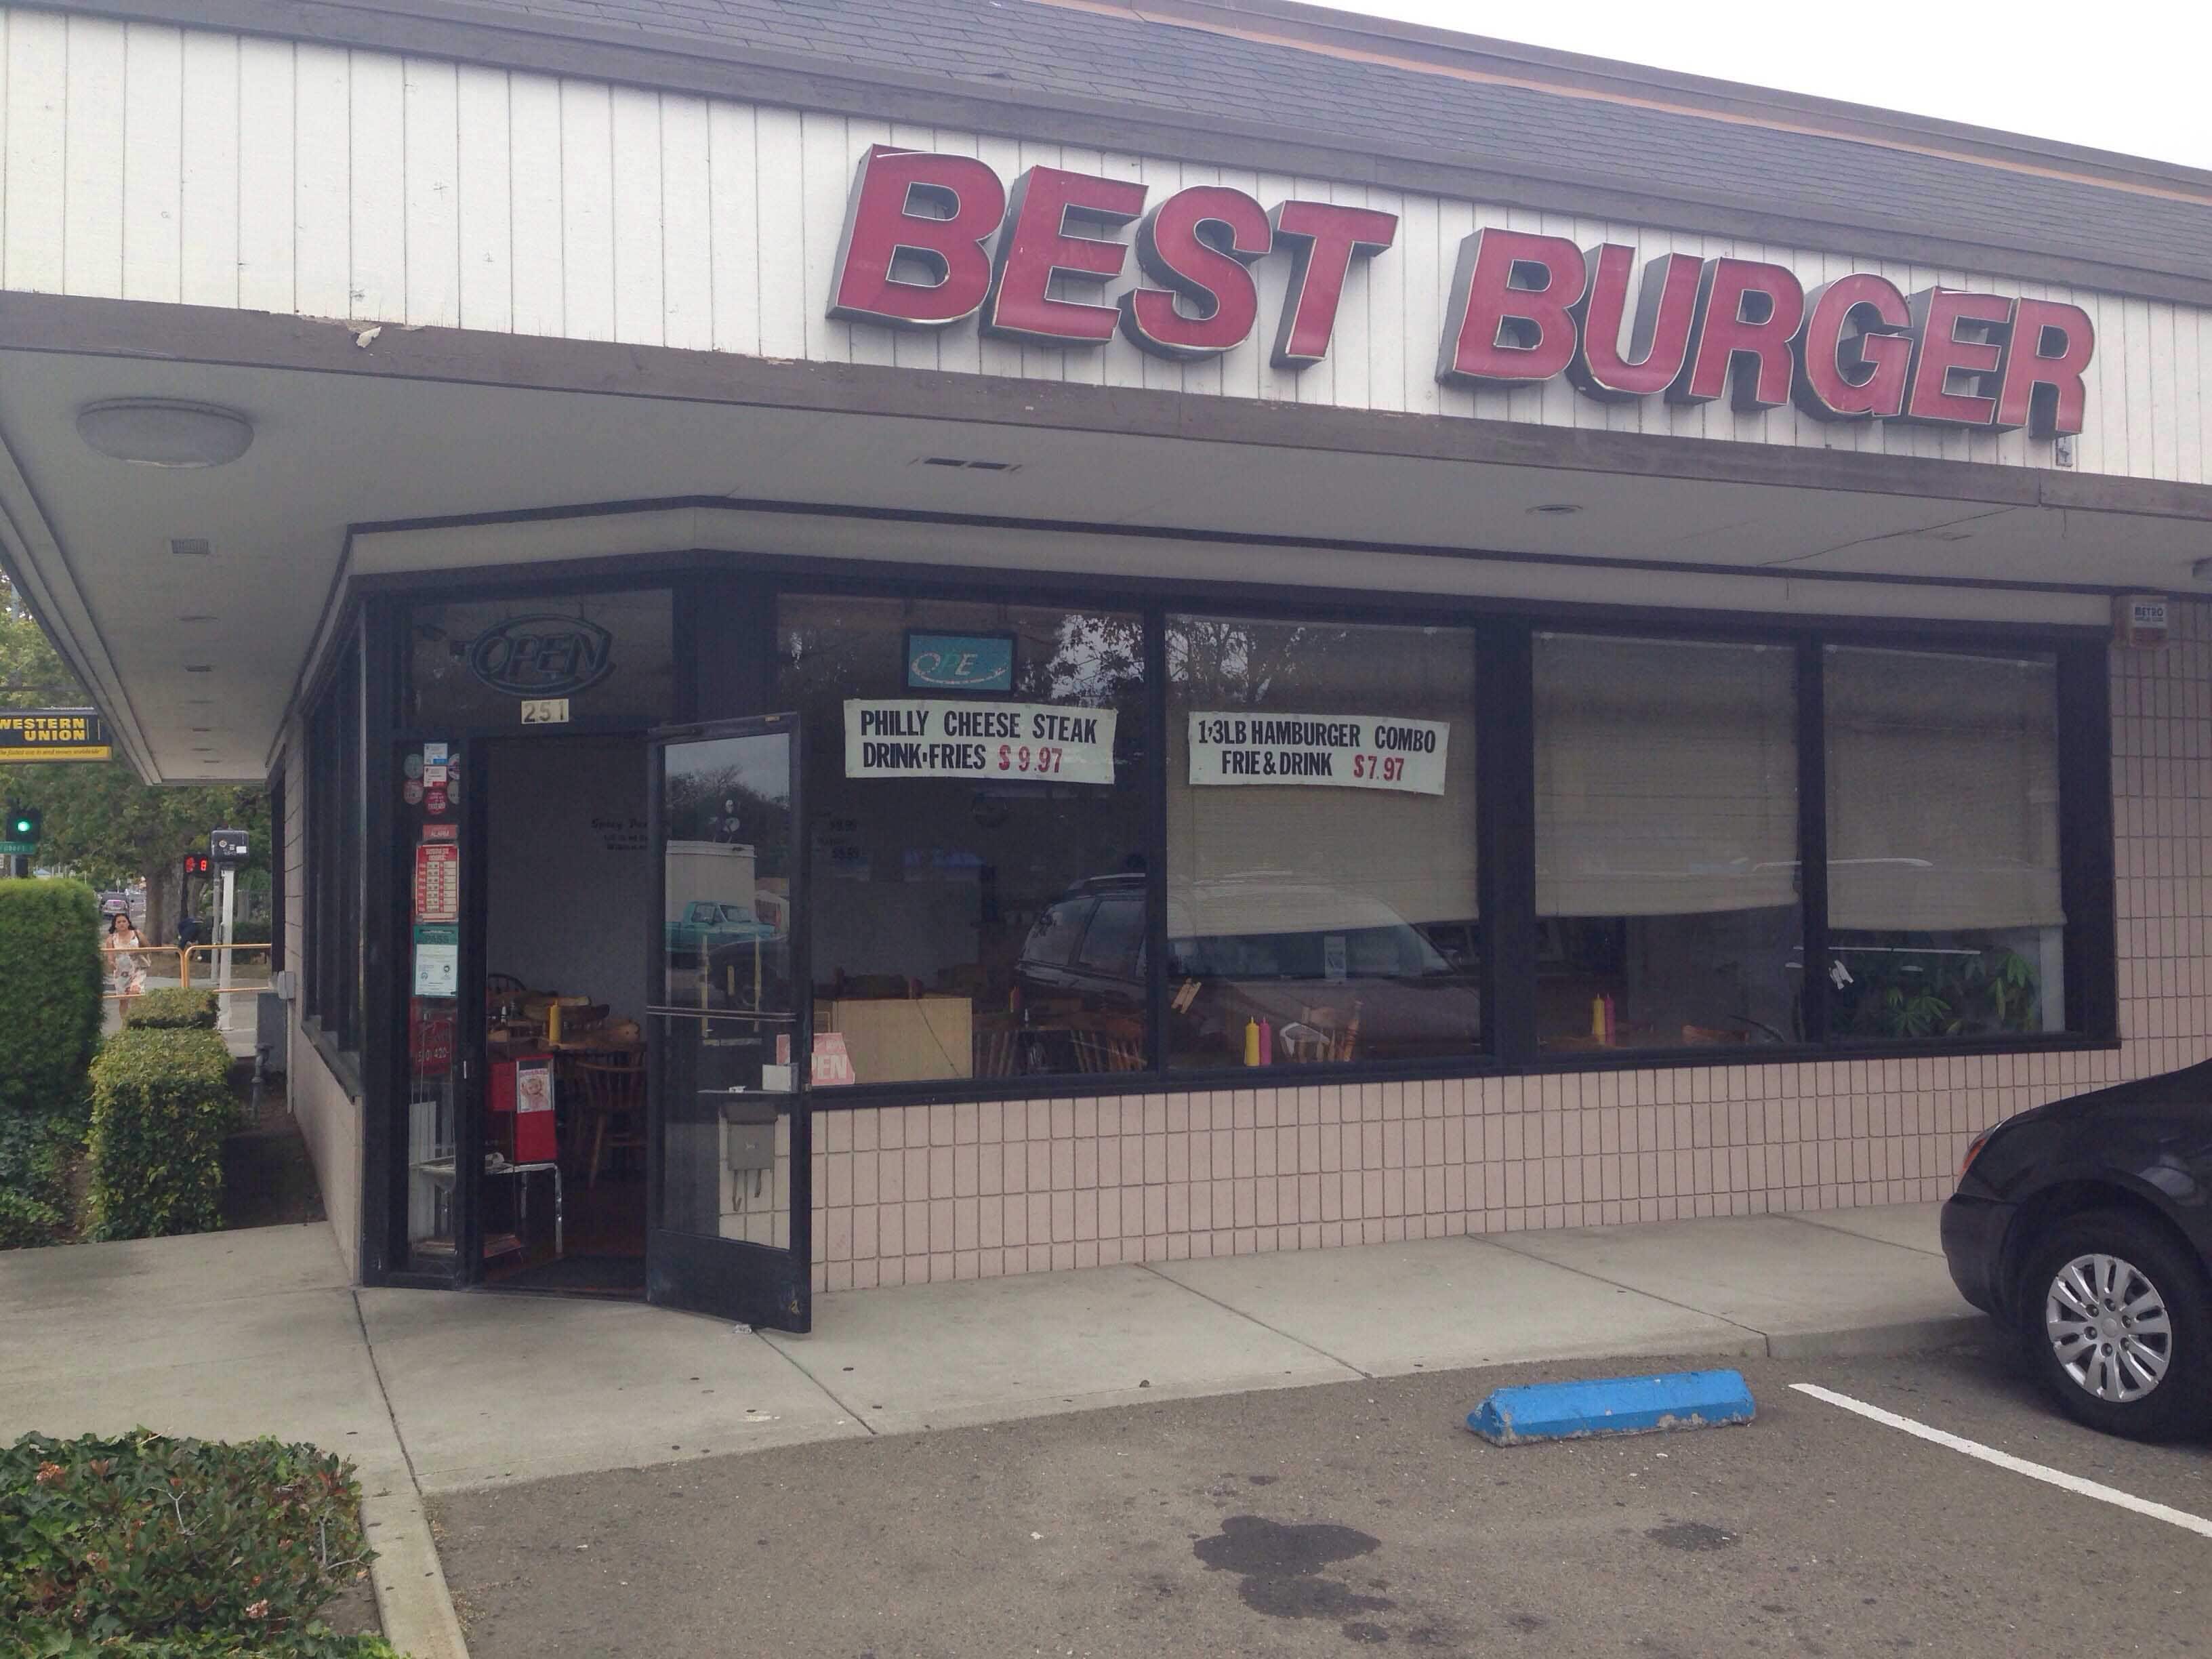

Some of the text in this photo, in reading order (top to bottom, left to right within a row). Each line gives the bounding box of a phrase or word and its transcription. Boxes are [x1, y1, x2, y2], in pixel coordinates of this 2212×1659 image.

[826, 143, 2095, 438] BEST BURGER
[0, 718, 85, 730] WESTERN
[523, 701, 566, 724] 251
[24, 730, 85, 741] UNION
[861, 710, 1097, 744] PHILLY CHEESE STEAK
[1251, 720, 1361, 747] HAMBURGER
[1374, 725, 1436, 754] COMBO
